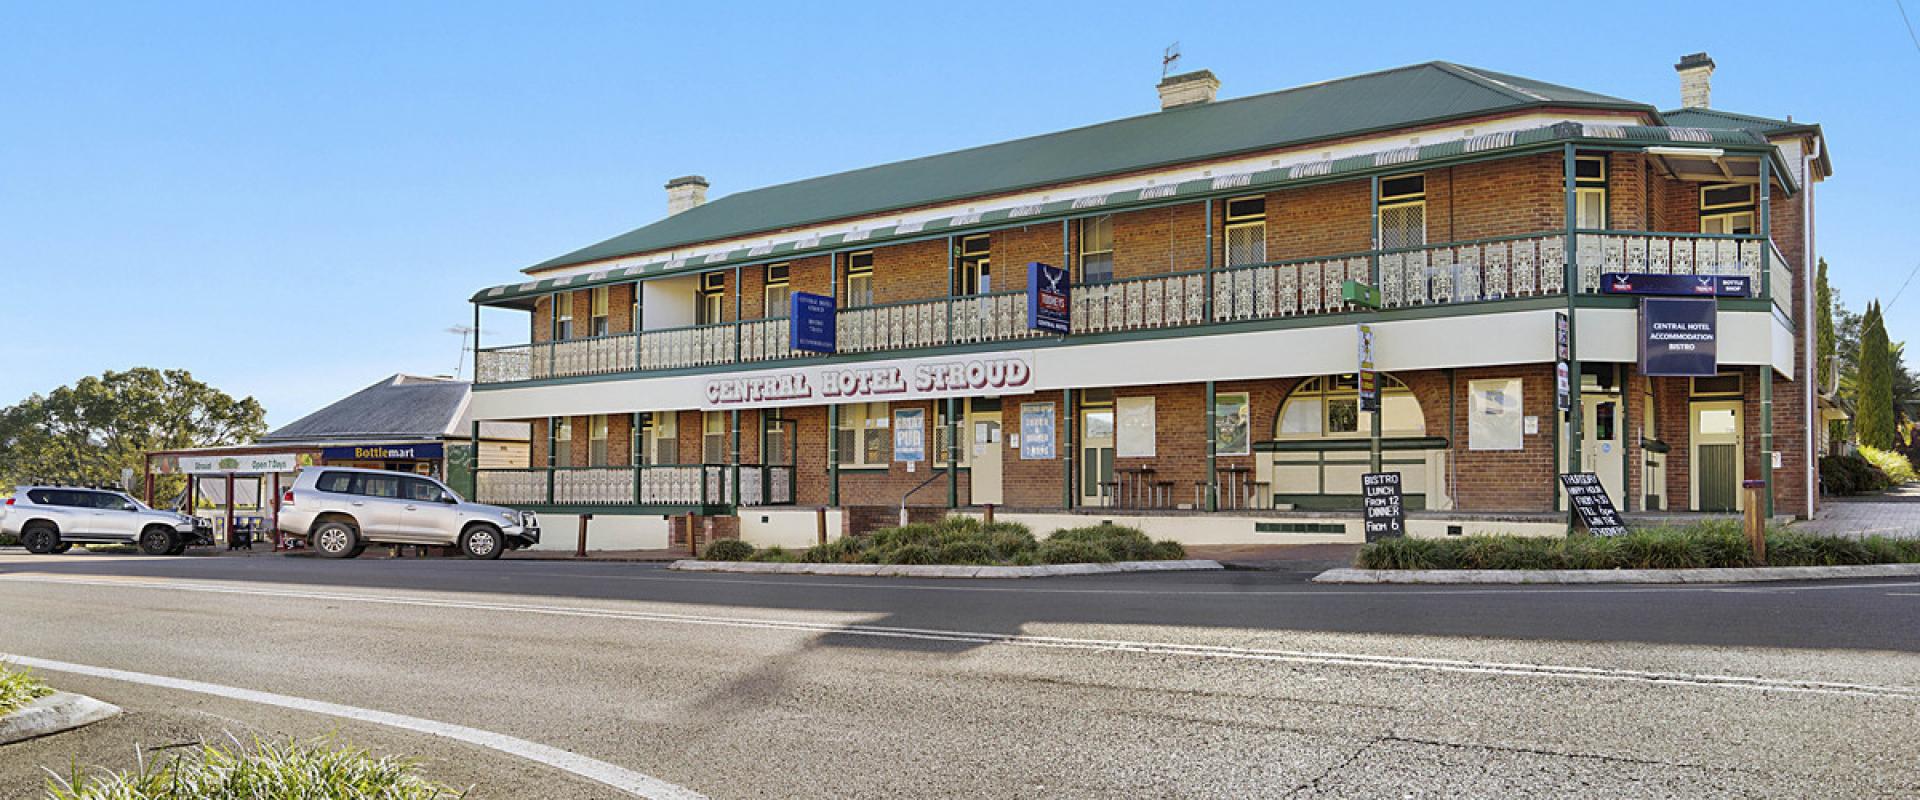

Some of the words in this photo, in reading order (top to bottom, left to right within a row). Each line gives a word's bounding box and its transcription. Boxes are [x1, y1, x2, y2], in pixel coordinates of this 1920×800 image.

[1653, 322, 1686, 330] CENTRAL
[1687, 322, 1711, 330] HOTEL
[1649, 332, 1714, 340] ACCOMMODATION
[1668, 343, 1696, 351] BISTRO
[705, 373, 812, 404] CENTRAL
[822, 367, 907, 398] HOTEL
[915, 358, 1031, 393] STROUD
[354, 446, 415, 459] Bottlemart
[251, 460, 268, 471] Open
[1364, 474, 1399, 486] BISTRO
[1367, 486, 1395, 497] LUNCH
[1388, 495, 1399, 506] 12
[1367, 505, 1400, 518] DINNER
[1391, 517, 1399, 531] 6
